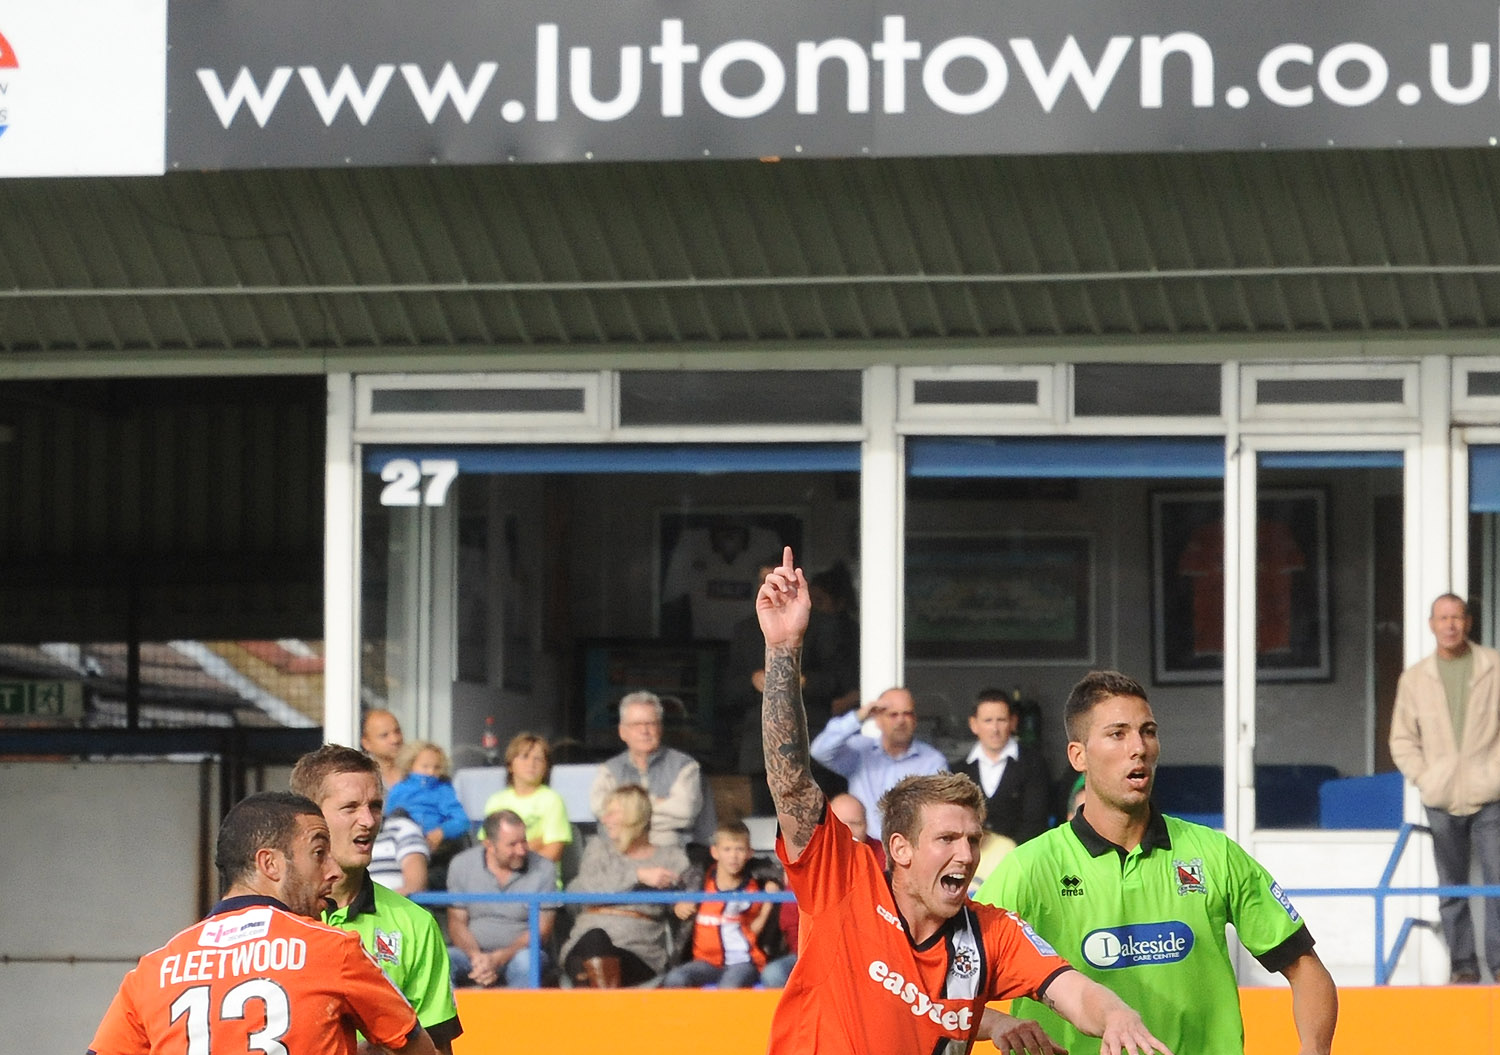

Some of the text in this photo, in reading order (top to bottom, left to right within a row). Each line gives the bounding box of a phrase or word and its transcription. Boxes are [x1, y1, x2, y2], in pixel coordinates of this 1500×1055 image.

[380, 459, 459, 507] 27
[159, 937, 306, 989] FLEETWOOD
[1100, 931, 1186, 959] Lakeside
